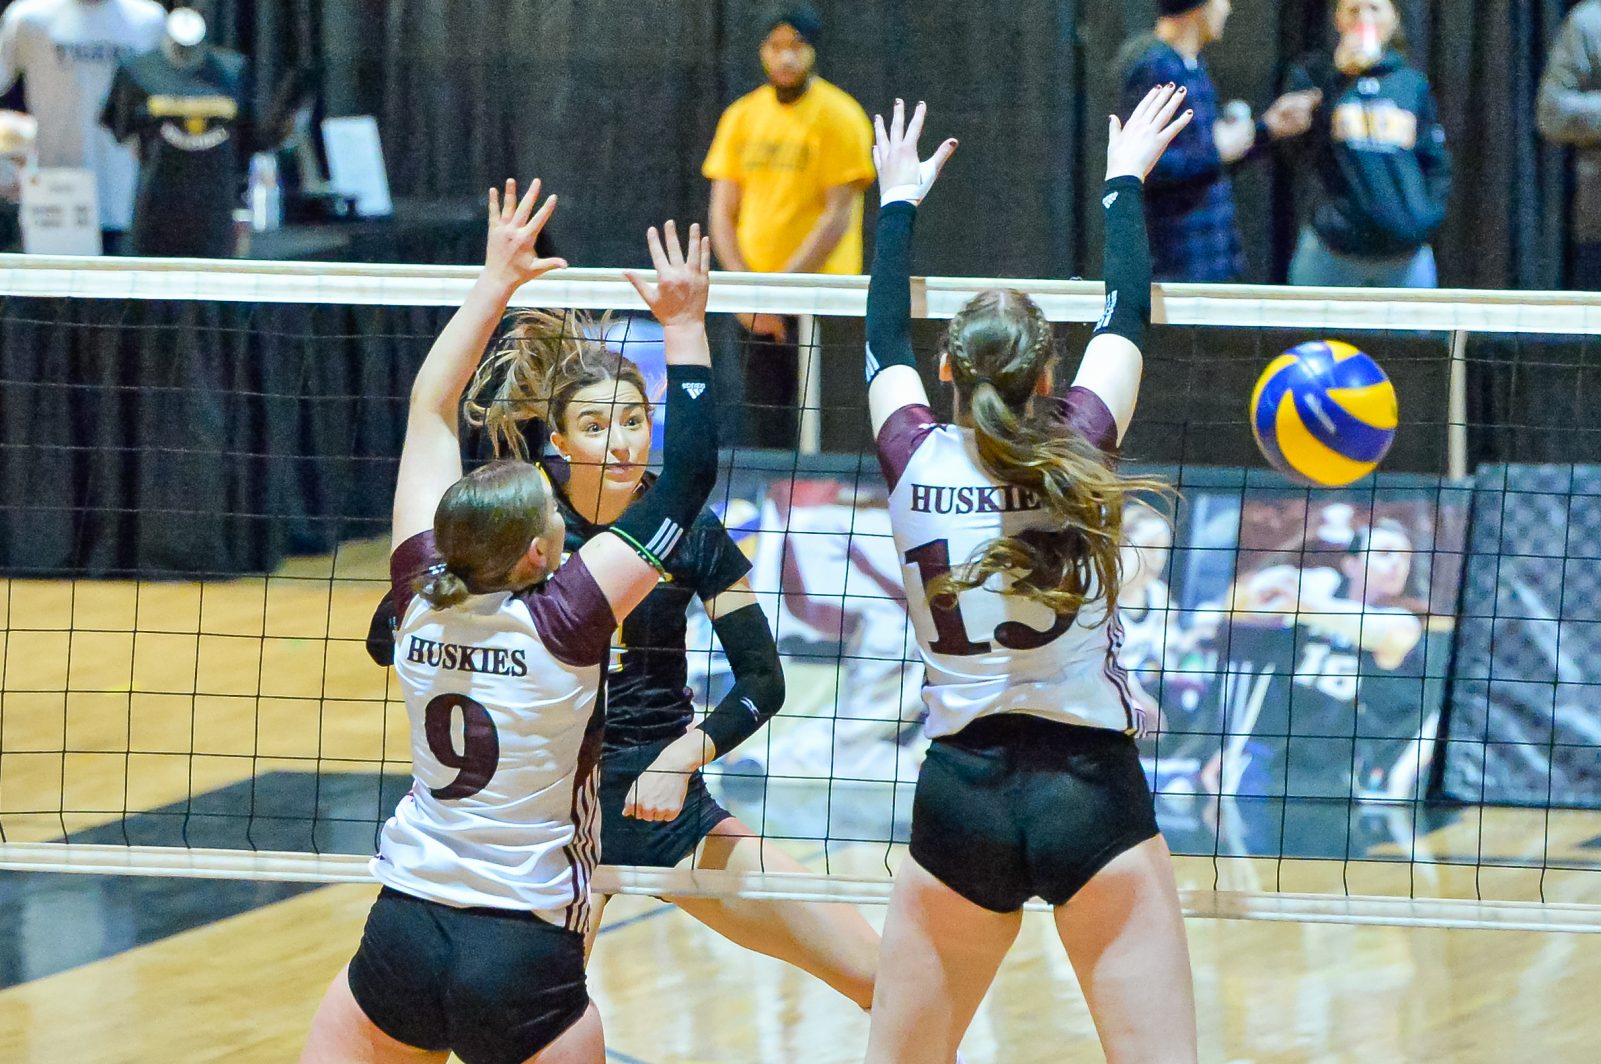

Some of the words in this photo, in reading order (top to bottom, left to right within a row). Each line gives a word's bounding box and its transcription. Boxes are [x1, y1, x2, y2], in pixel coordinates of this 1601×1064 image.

[911, 484, 1042, 514] HUSKIE
[407, 635, 528, 677] HUSKIES
[424, 692, 500, 800] 9
